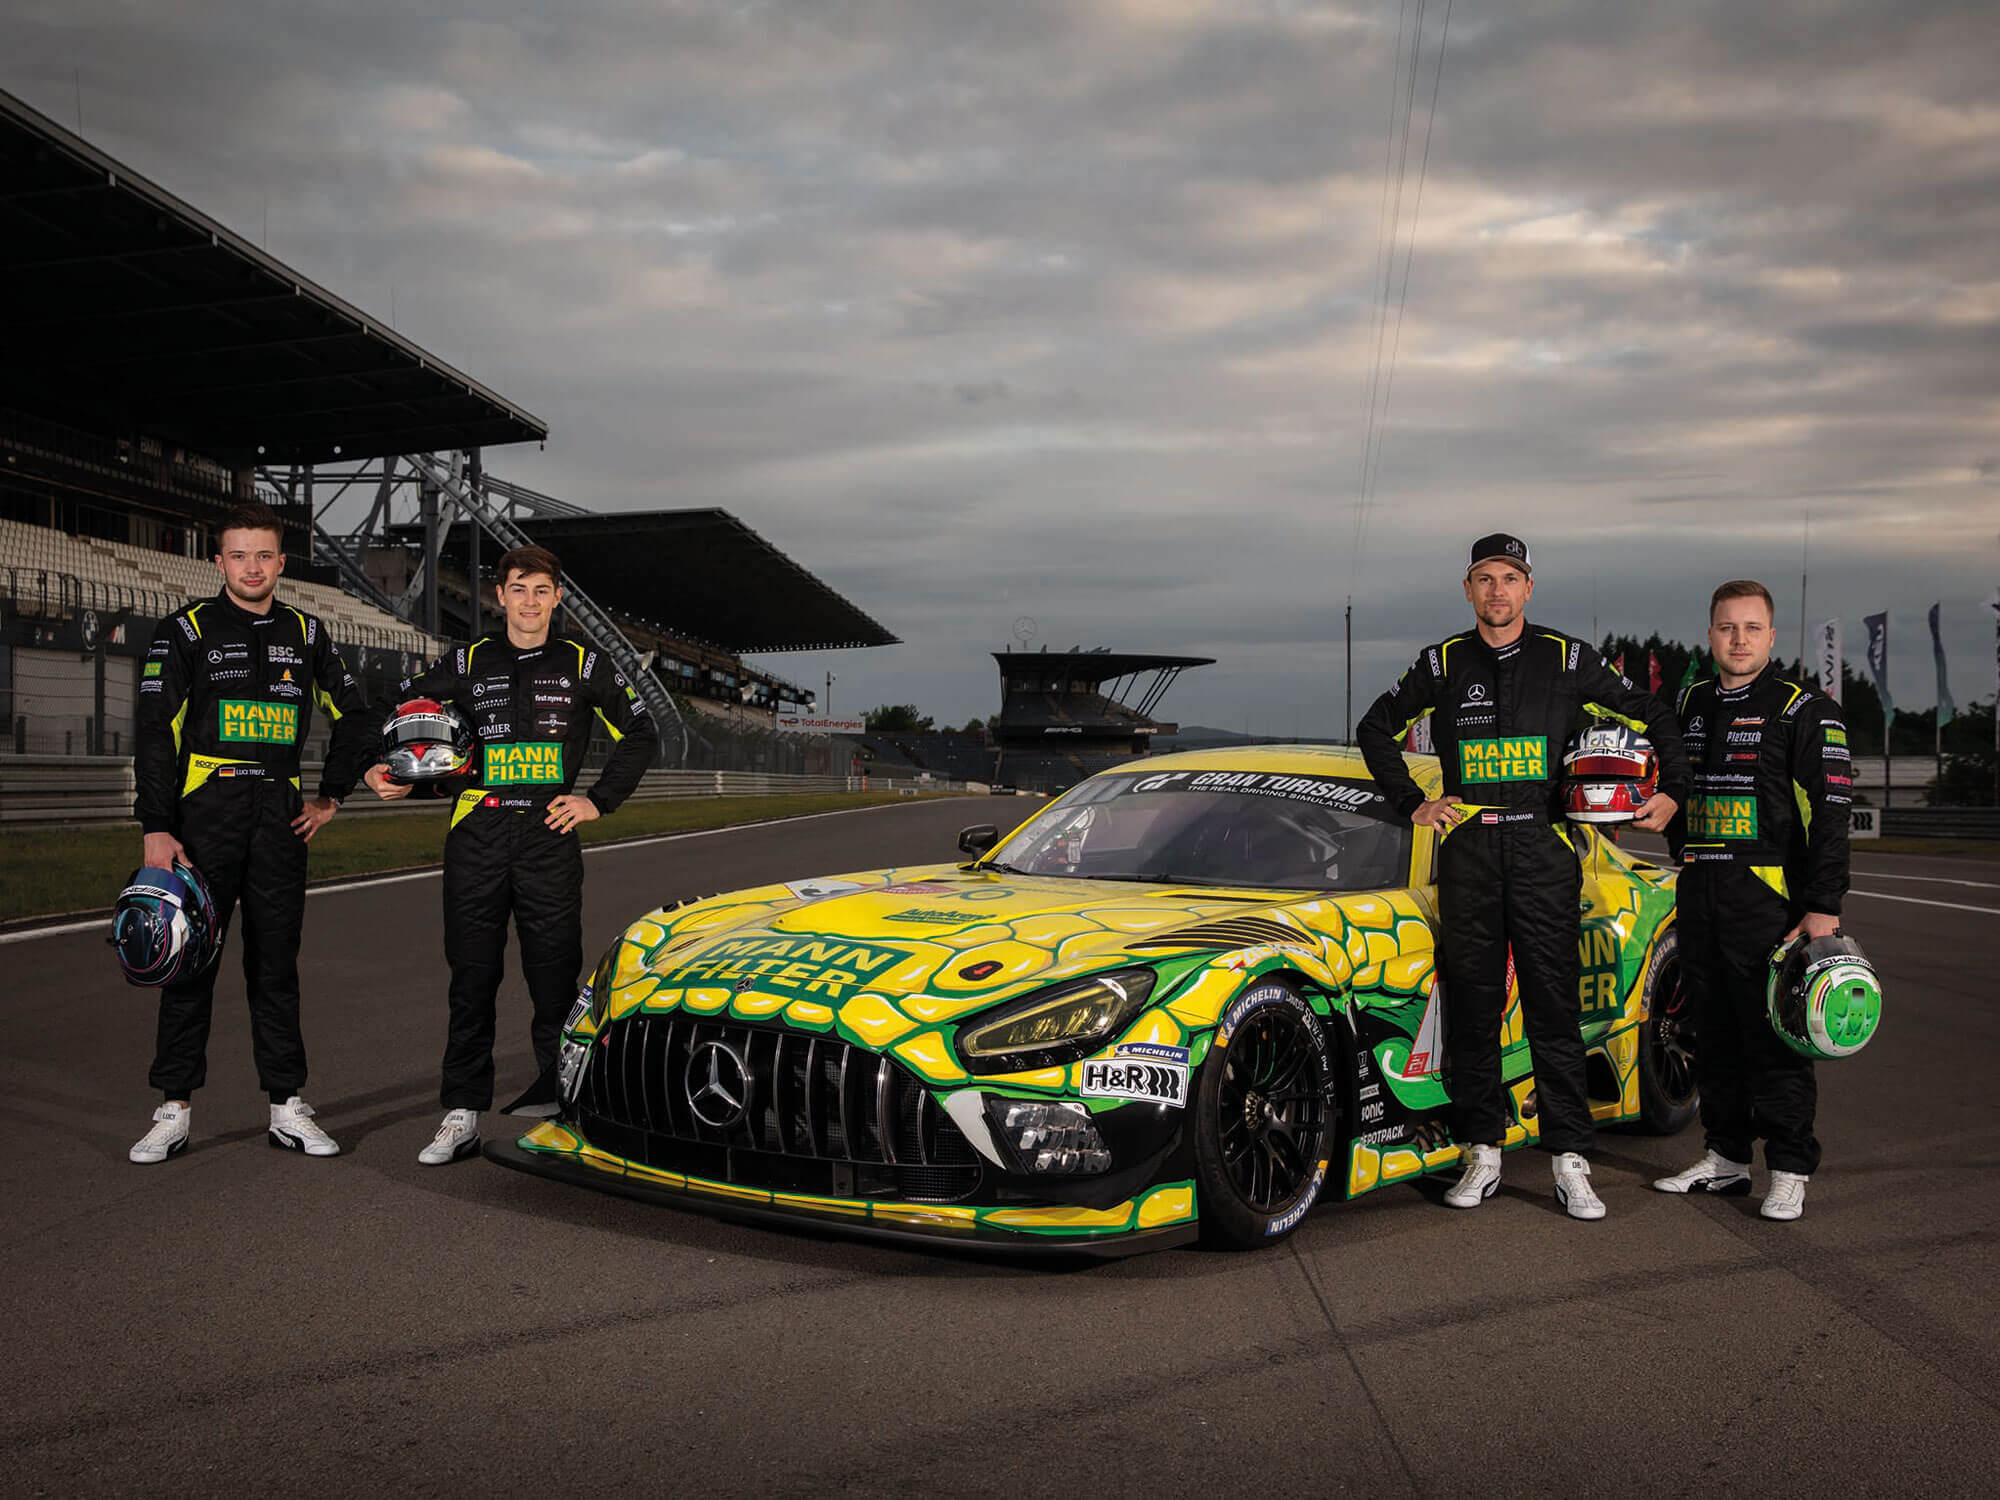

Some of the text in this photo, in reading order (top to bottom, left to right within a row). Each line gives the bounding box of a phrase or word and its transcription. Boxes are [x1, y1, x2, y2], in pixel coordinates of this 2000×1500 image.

[268, 645, 294, 657] BSC
[224, 703, 295, 724] MANN
[224, 721, 295, 741] FILTER
[478, 723, 512, 737] CIMIER
[801, 718, 863, 729] TotalEnergies
[487, 746, 558, 764] MANN
[1463, 741, 1542, 760] MANN
[1591, 747, 1636, 759] AMG
[488, 763, 559, 781] FILTER
[1464, 759, 1543, 779] FILTER
[1190, 772, 1375, 805] GRAN TURISMO
[1187, 785, 1208, 793] THE
[1239, 787, 1287, 798] DRIVING
[1287, 791, 1359, 812] SIMULATOR
[1687, 799, 1751, 817] MANN
[1506, 813, 1533, 822] BAUMANN
[706, 940, 895, 971] MANN
[671, 959, 858, 997] FILTER
[1232, 988, 1283, 1025] MICHELIN
[1131, 1047, 1184, 1059] MICHELIN
[1086, 1064, 1146, 1092] H&R
[1270, 1185, 1317, 1233] MICHELIN
